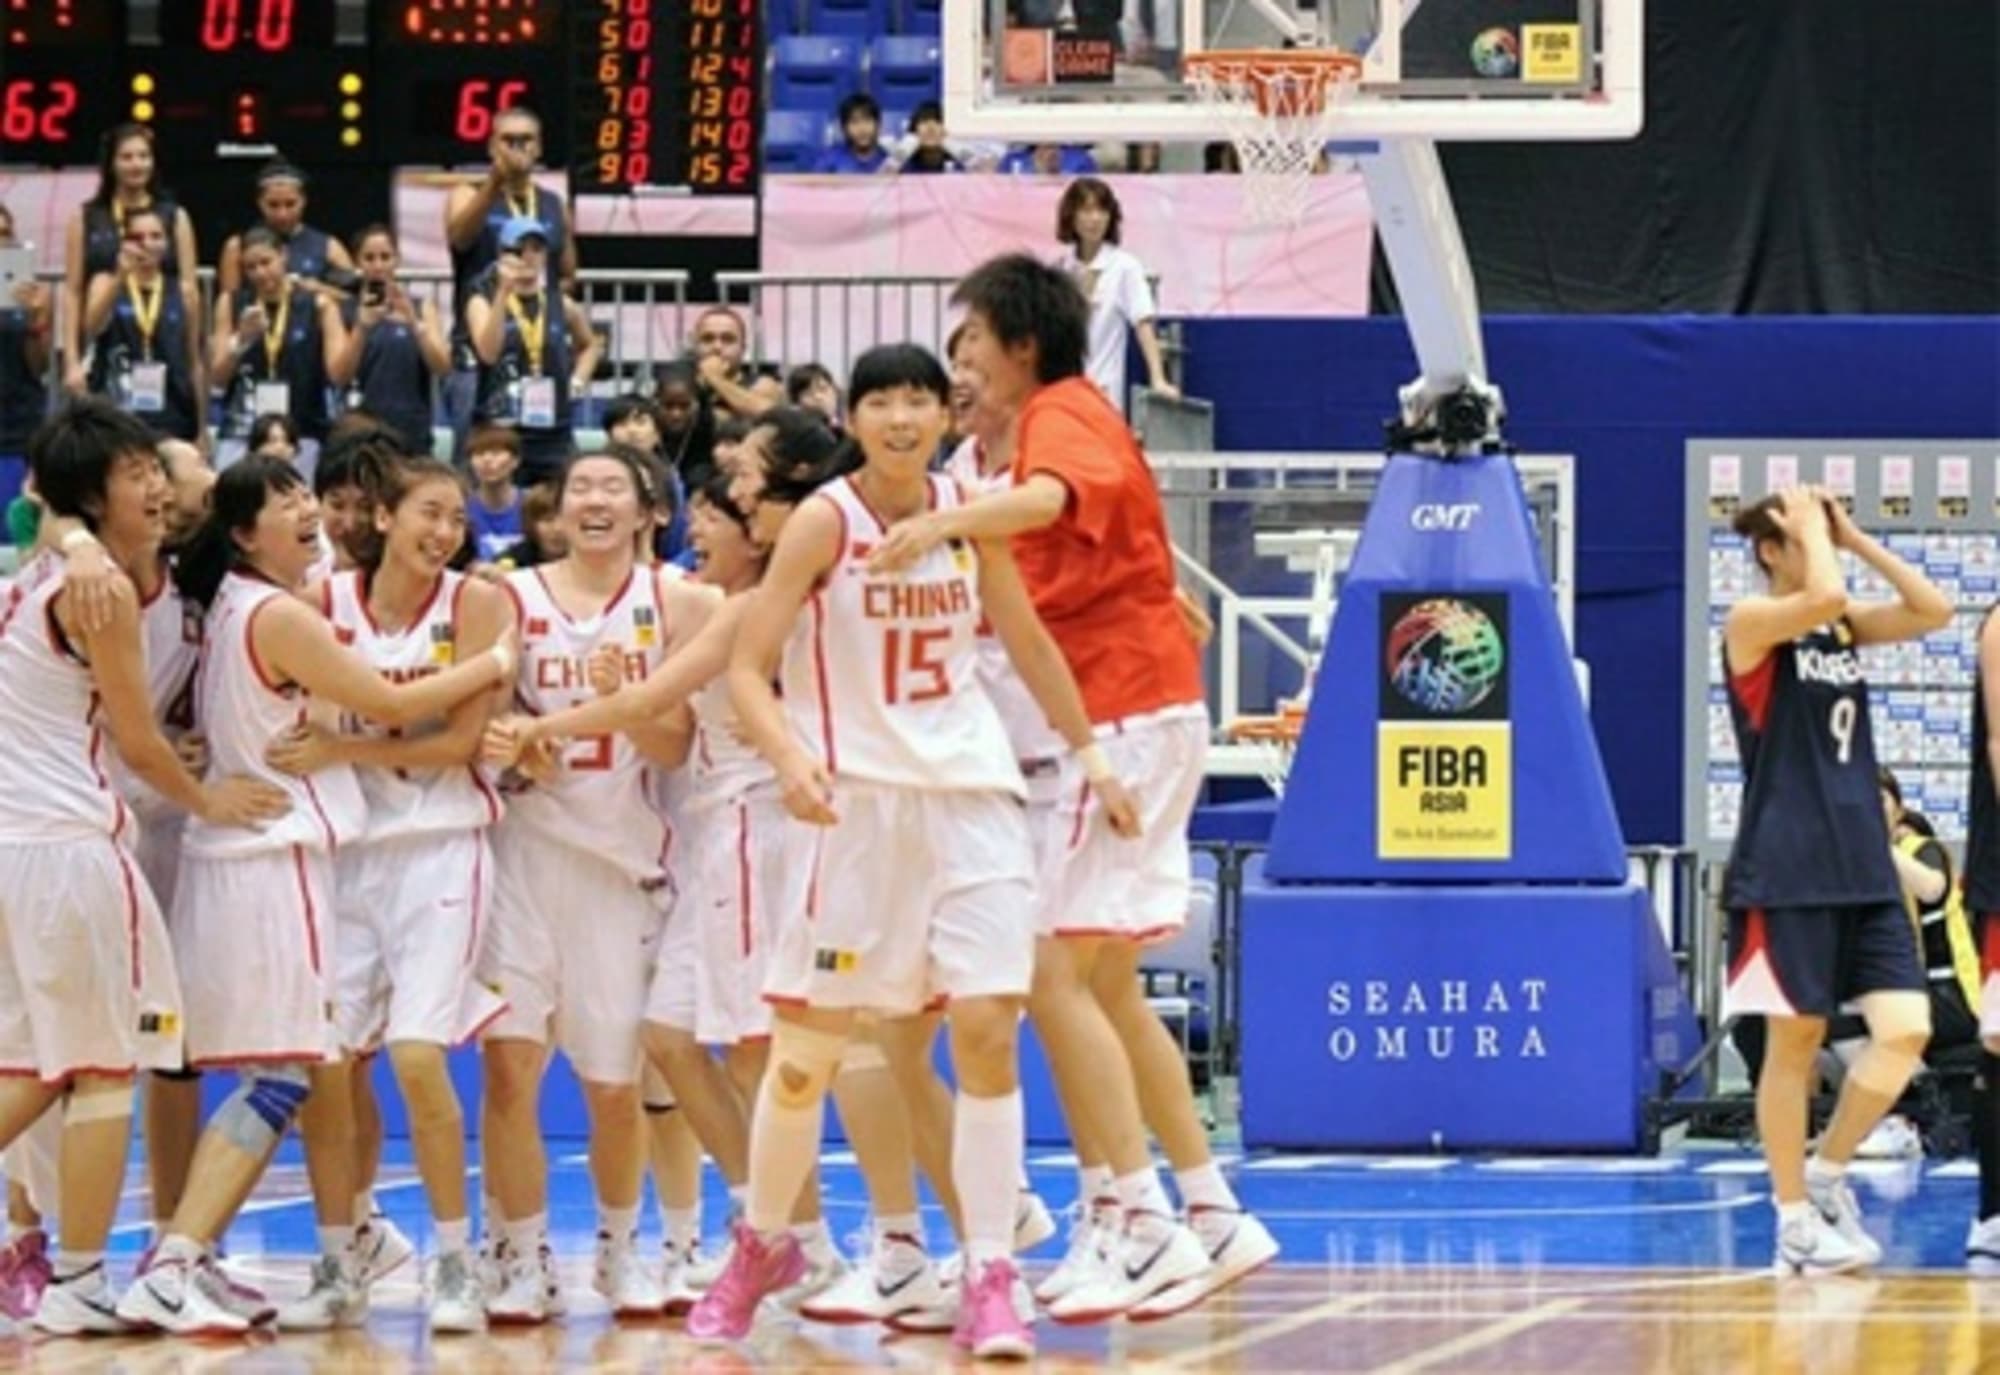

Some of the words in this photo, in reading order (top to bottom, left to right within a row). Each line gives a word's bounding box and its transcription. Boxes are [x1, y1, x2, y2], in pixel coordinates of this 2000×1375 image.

[600, 20, 621, 49] 5
[627, 19, 650, 49] 0
[690, 22, 724, 48] 11
[599, 53, 621, 83] 6
[690, 53, 723, 83] 12
[729, 56, 751, 81] 4
[3, 80, 77, 141] 62
[603, 86, 622, 114] 7
[627, 86, 650, 117] 0
[690, 86, 722, 117] 13
[728, 86, 751, 117] 0
[598, 119, 621, 149] 8
[629, 119, 650, 149] 3
[690, 121, 722, 148] 14
[728, 119, 751, 150] 0
[599, 152, 621, 183] 9
[626, 152, 650, 183] 0
[690, 152, 722, 183] 15
[727, 153, 751, 184] 2
[1411, 504, 1481, 531] GMT
[865, 578, 971, 618] CHINA
[884, 626, 952, 704] 15
[1829, 696, 1857, 763] 9
[1398, 745, 1488, 788] FIBA
[1419, 790, 1468, 814] ASIA
[1328, 979, 1547, 1015] SEAHAT
[1329, 1025, 1547, 1060] OMURA
